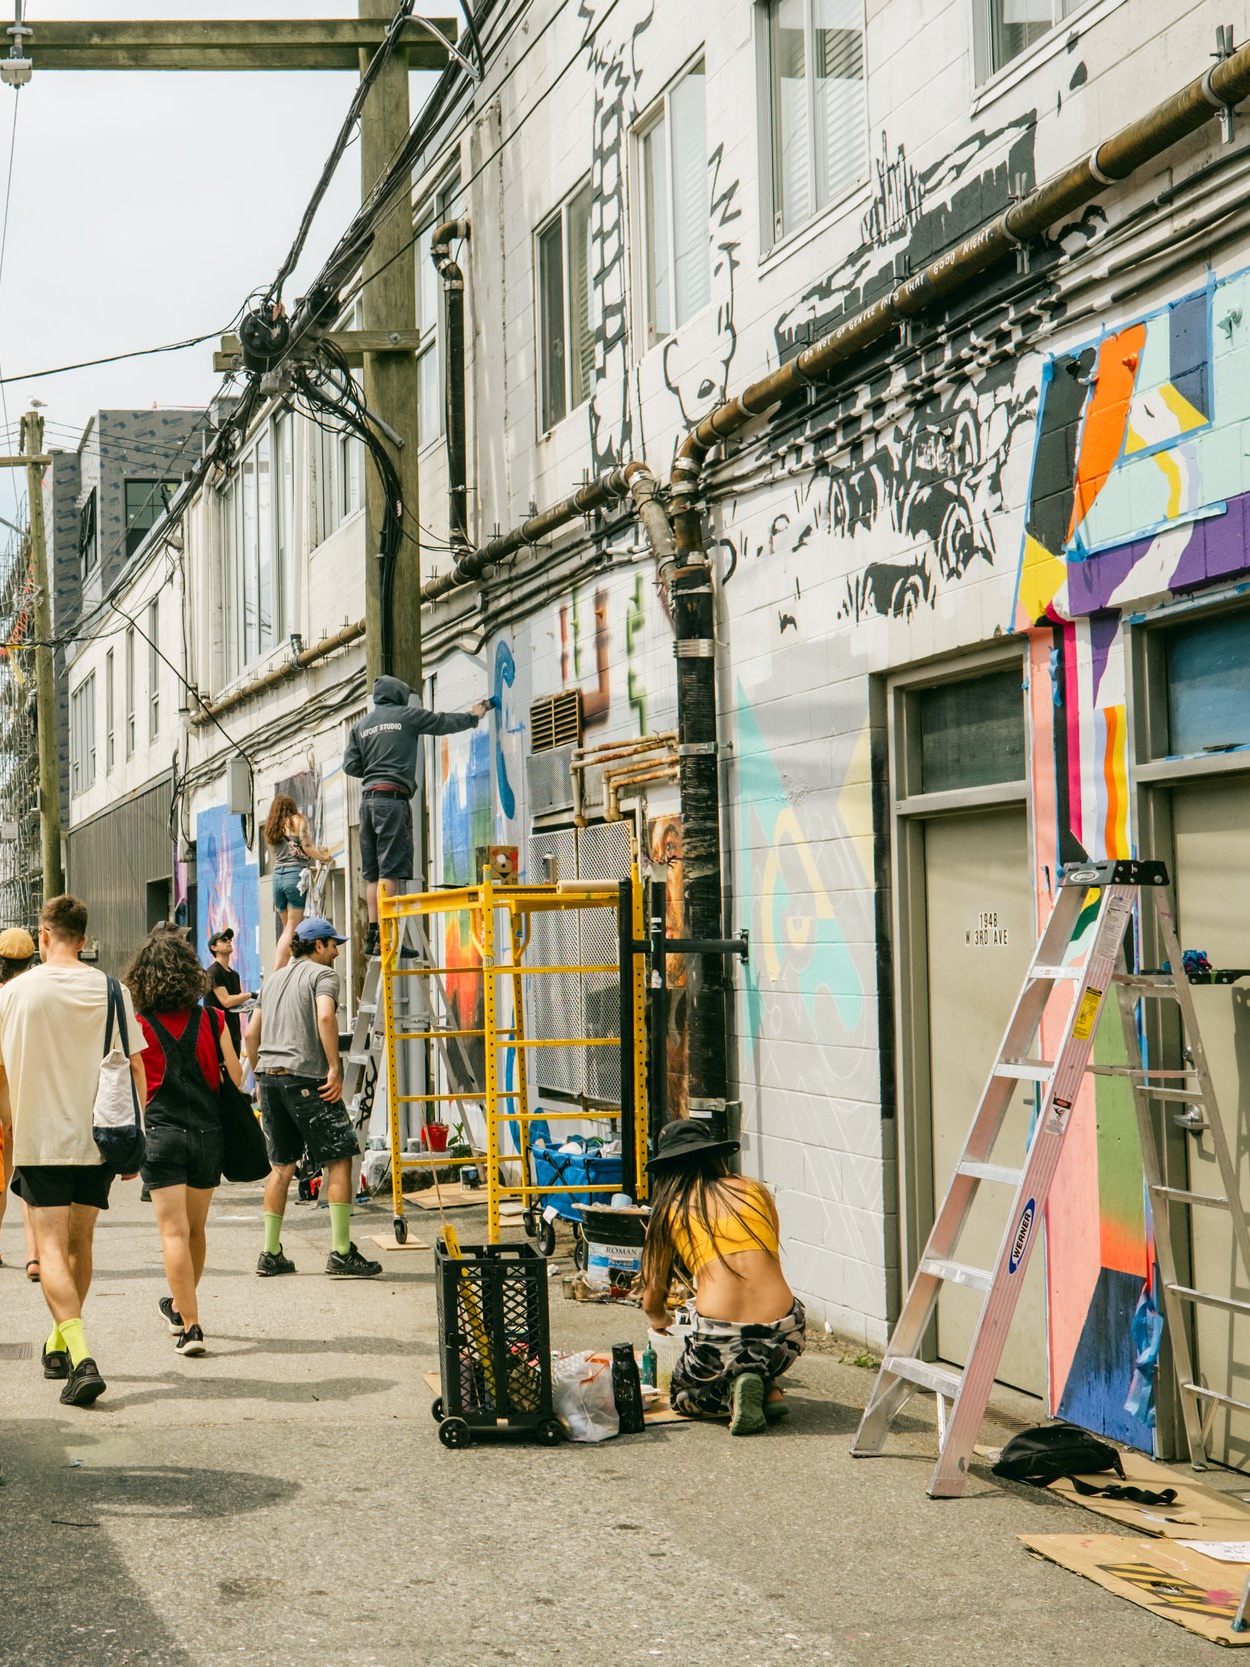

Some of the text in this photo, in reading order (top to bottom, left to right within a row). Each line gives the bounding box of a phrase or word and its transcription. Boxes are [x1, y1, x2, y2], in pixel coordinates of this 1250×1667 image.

[804, 350, 813, 362] DO
[816, 335, 831, 351] NOT
[836, 326, 846, 338] GO
[849, 304, 876, 330] GENTLE
[905, 274, 925, 295] THAT
[933, 252, 956, 275] GOOD
[962, 227, 994, 255] NIGHT.
[360, 725, 378, 739] LAYOUT
[974, 930, 989, 945] 3RD
[993, 929, 1008, 945] AVE
[1013, 1213, 1031, 1258] WERNER
[606, 1247, 637, 1255] ROMAN
